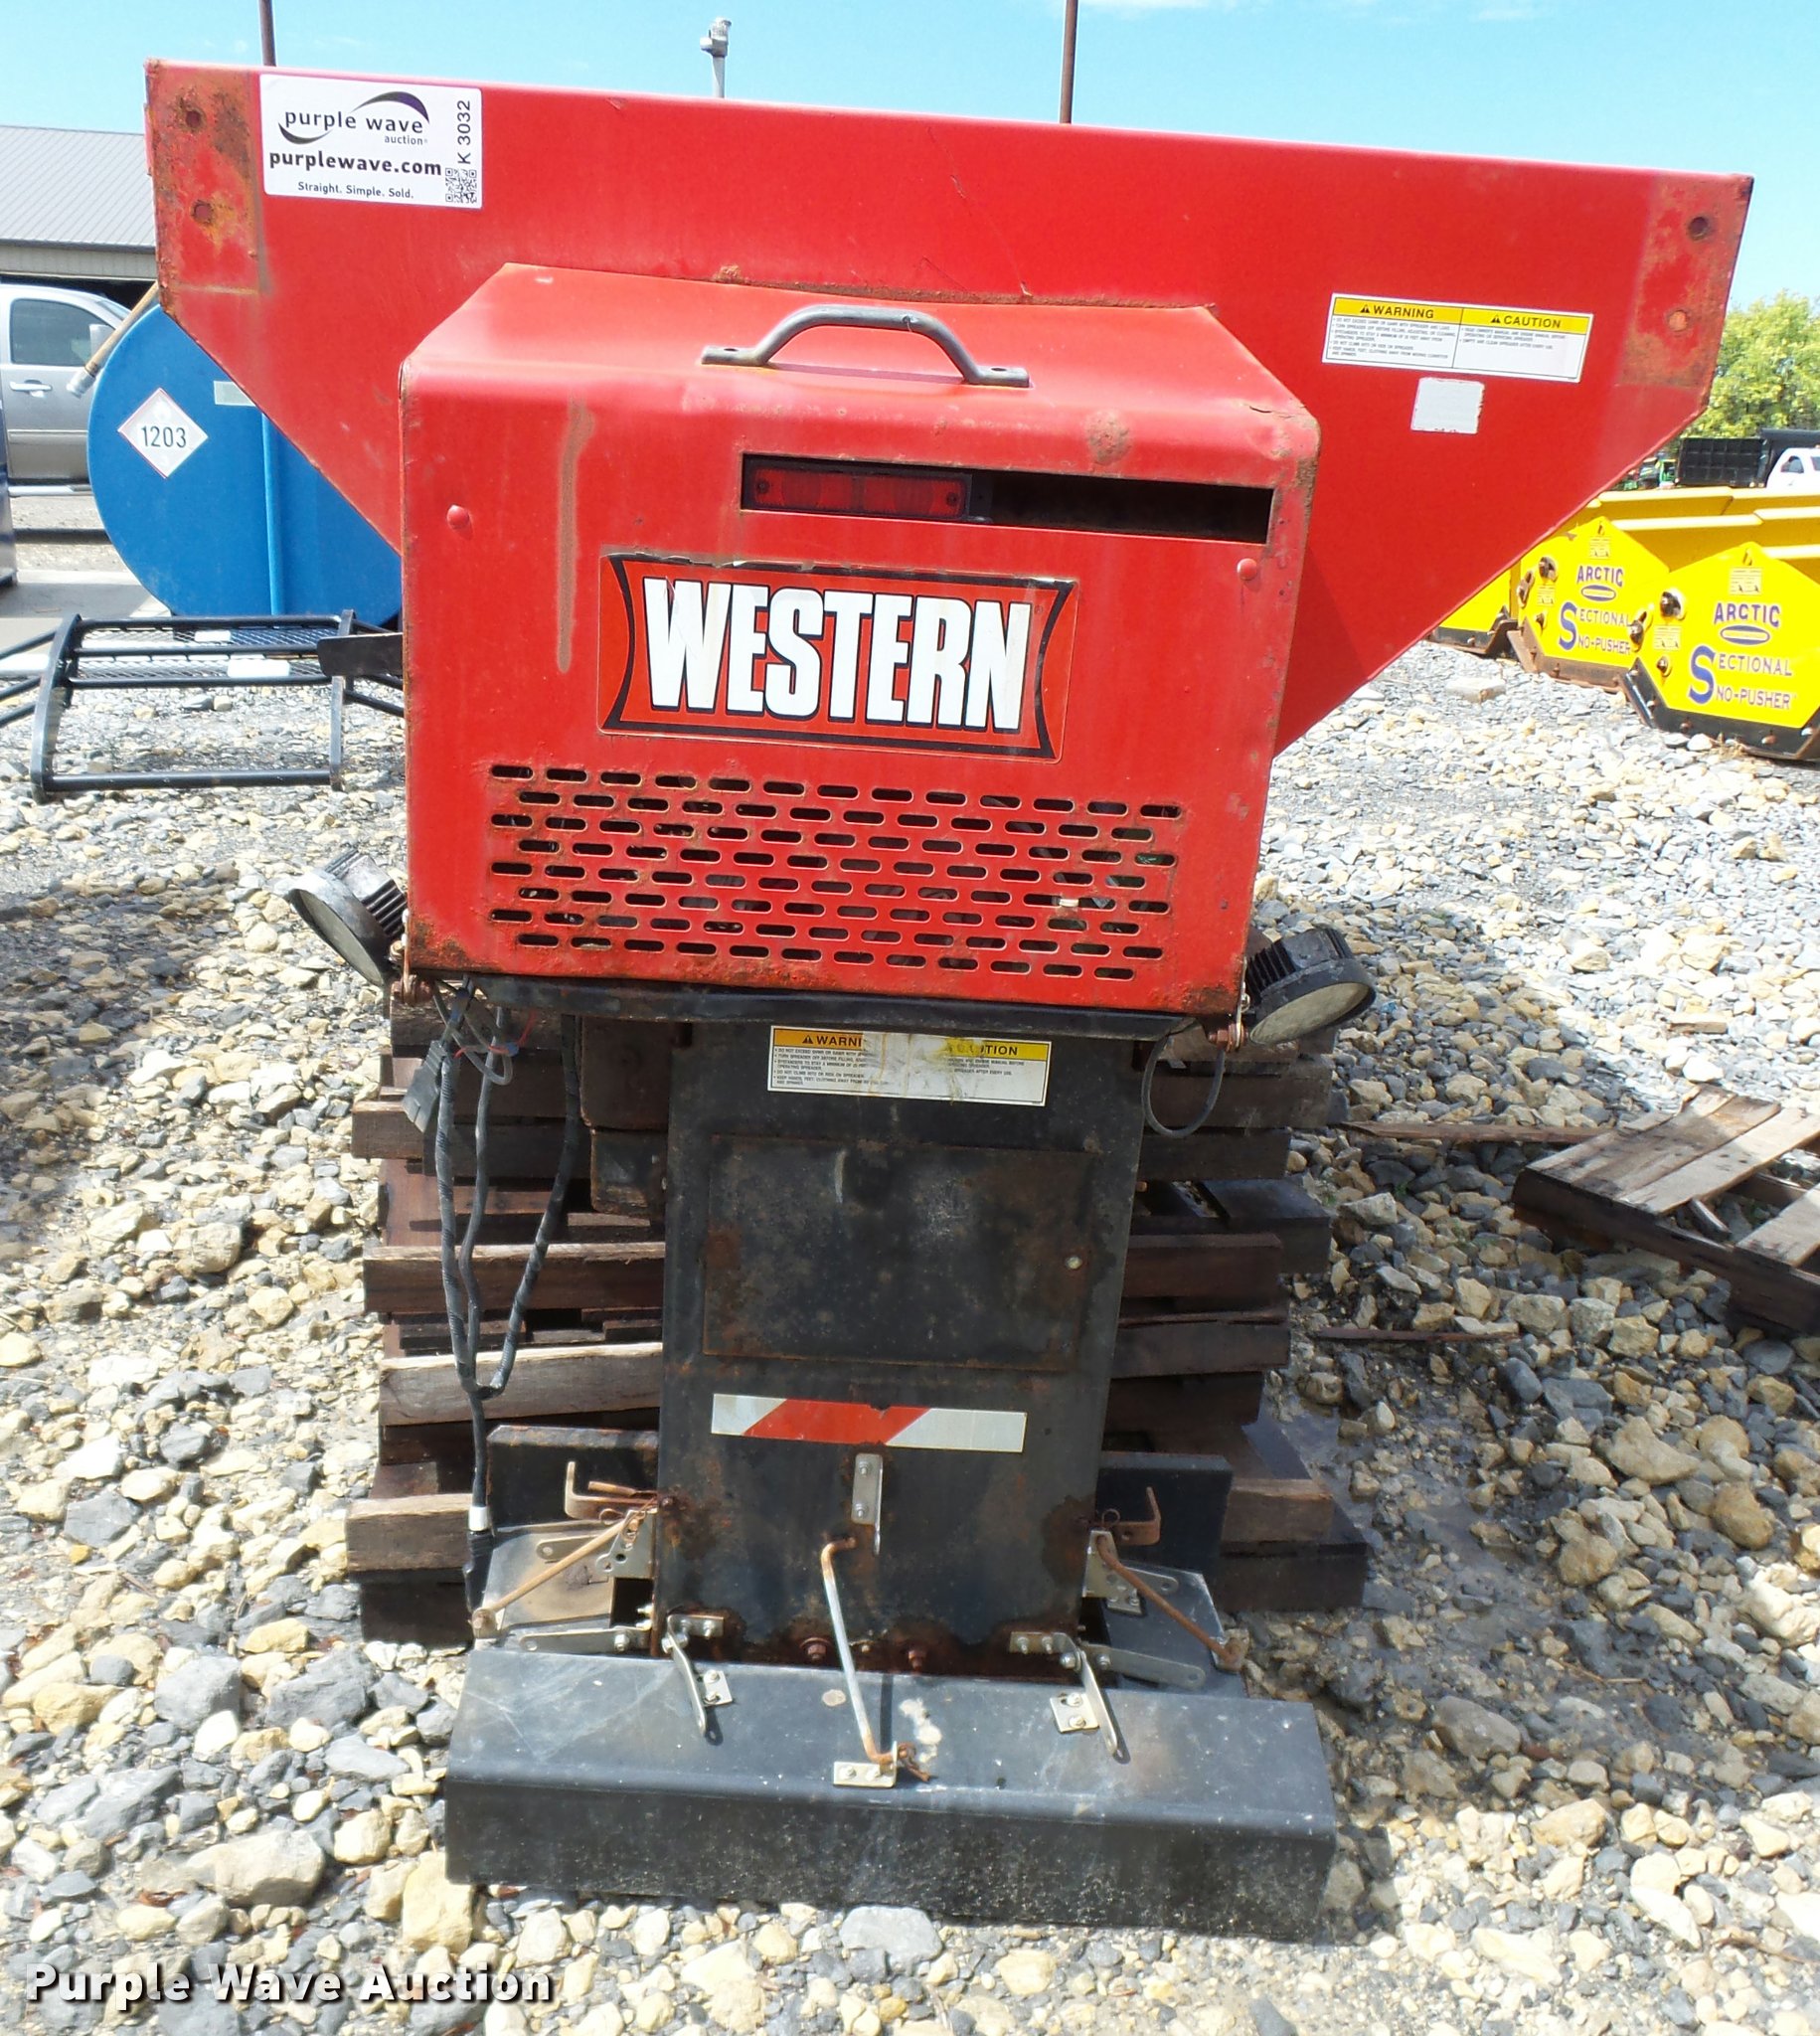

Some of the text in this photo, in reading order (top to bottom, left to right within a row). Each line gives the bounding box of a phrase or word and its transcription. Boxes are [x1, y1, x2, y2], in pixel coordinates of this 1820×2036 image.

[284, 110, 423, 134] purple wave
[456, 100, 471, 165] K 3032
[269, 150, 442, 176] purplewave.com
[297, 181, 414, 199] Straight. Simple. Sold.
[1373, 304, 1434, 319] WARNING
[1503, 315, 1562, 329] CAUTION
[141, 424, 187, 448] 1203
[1576, 565, 1624, 588] ARCTIC
[1713, 601, 1781, 628] ARCTIC
[642, 577, 1034, 734] WESTERN
[816, 1035, 863, 1048] WARNI
